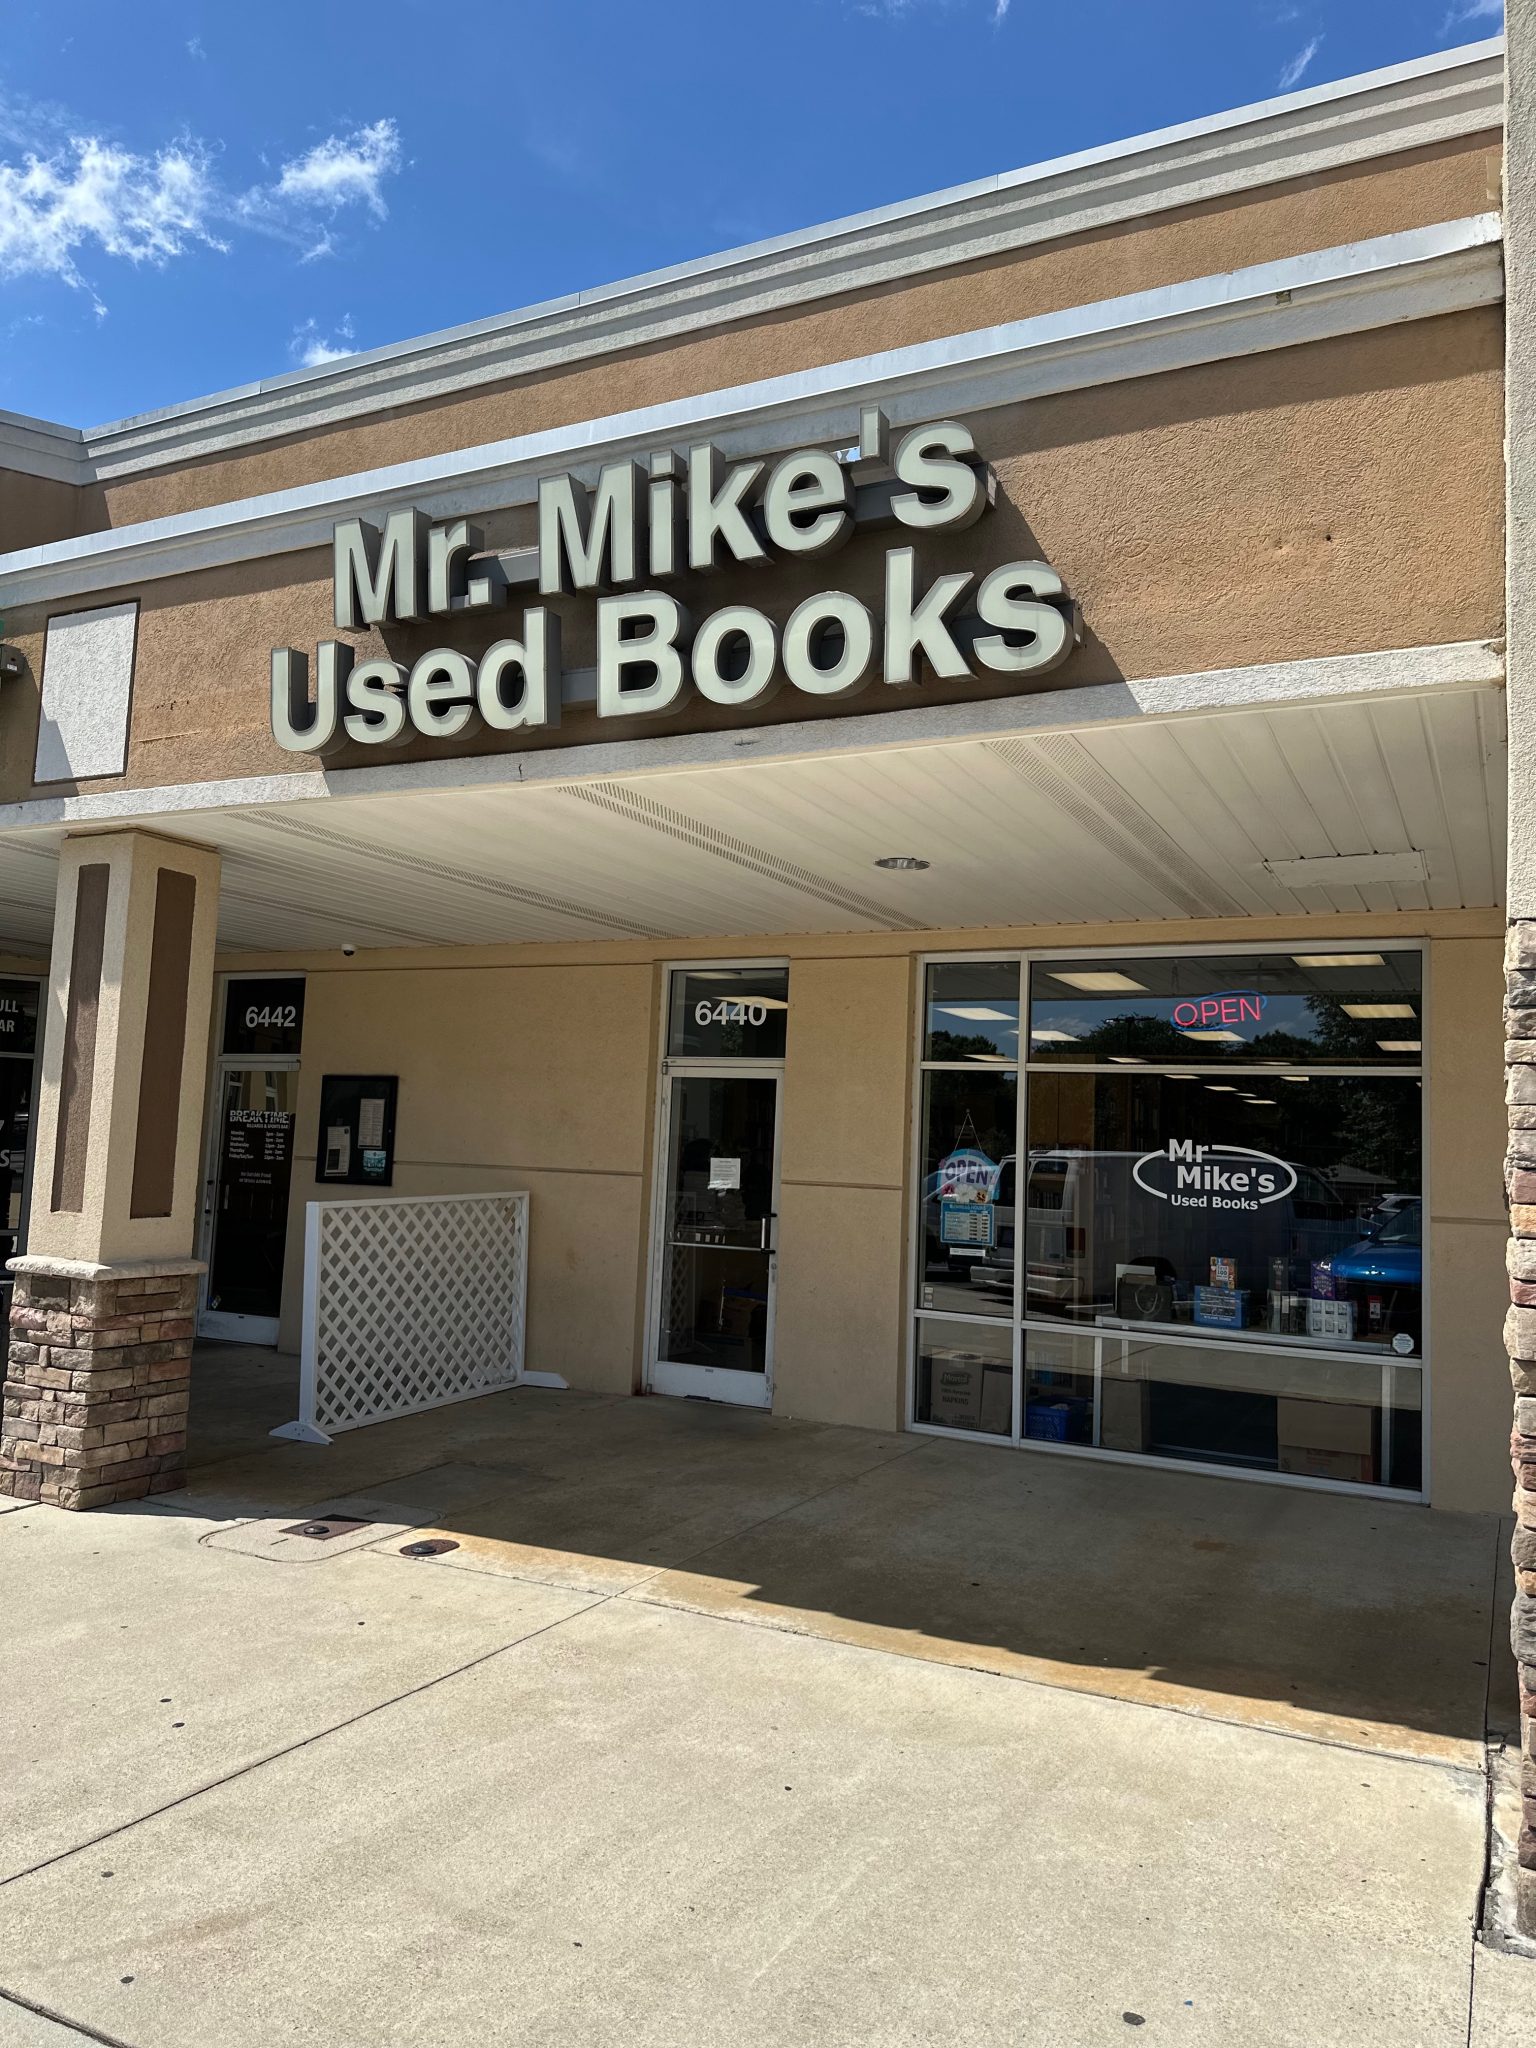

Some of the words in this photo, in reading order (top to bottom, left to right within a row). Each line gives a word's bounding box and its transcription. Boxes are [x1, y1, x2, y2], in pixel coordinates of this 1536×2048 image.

[333, 507, 492, 631] Mr.
[537, 405, 987, 596] Mike's
[271, 606, 550, 753] Used
[596, 547, 1070, 719] Books
[245, 1005, 297, 1028] 6442
[694, 1000, 767, 1026] 6440
[1173, 996, 1262, 1027] OPEN
[1168, 1138, 1209, 1163] Mr
[944, 1159, 988, 1186] OPEN
[1177, 1165, 1276, 1194] Mike's
[1171, 1193, 1208, 1208] Used
[1212, 1196, 1259, 1210] Books
